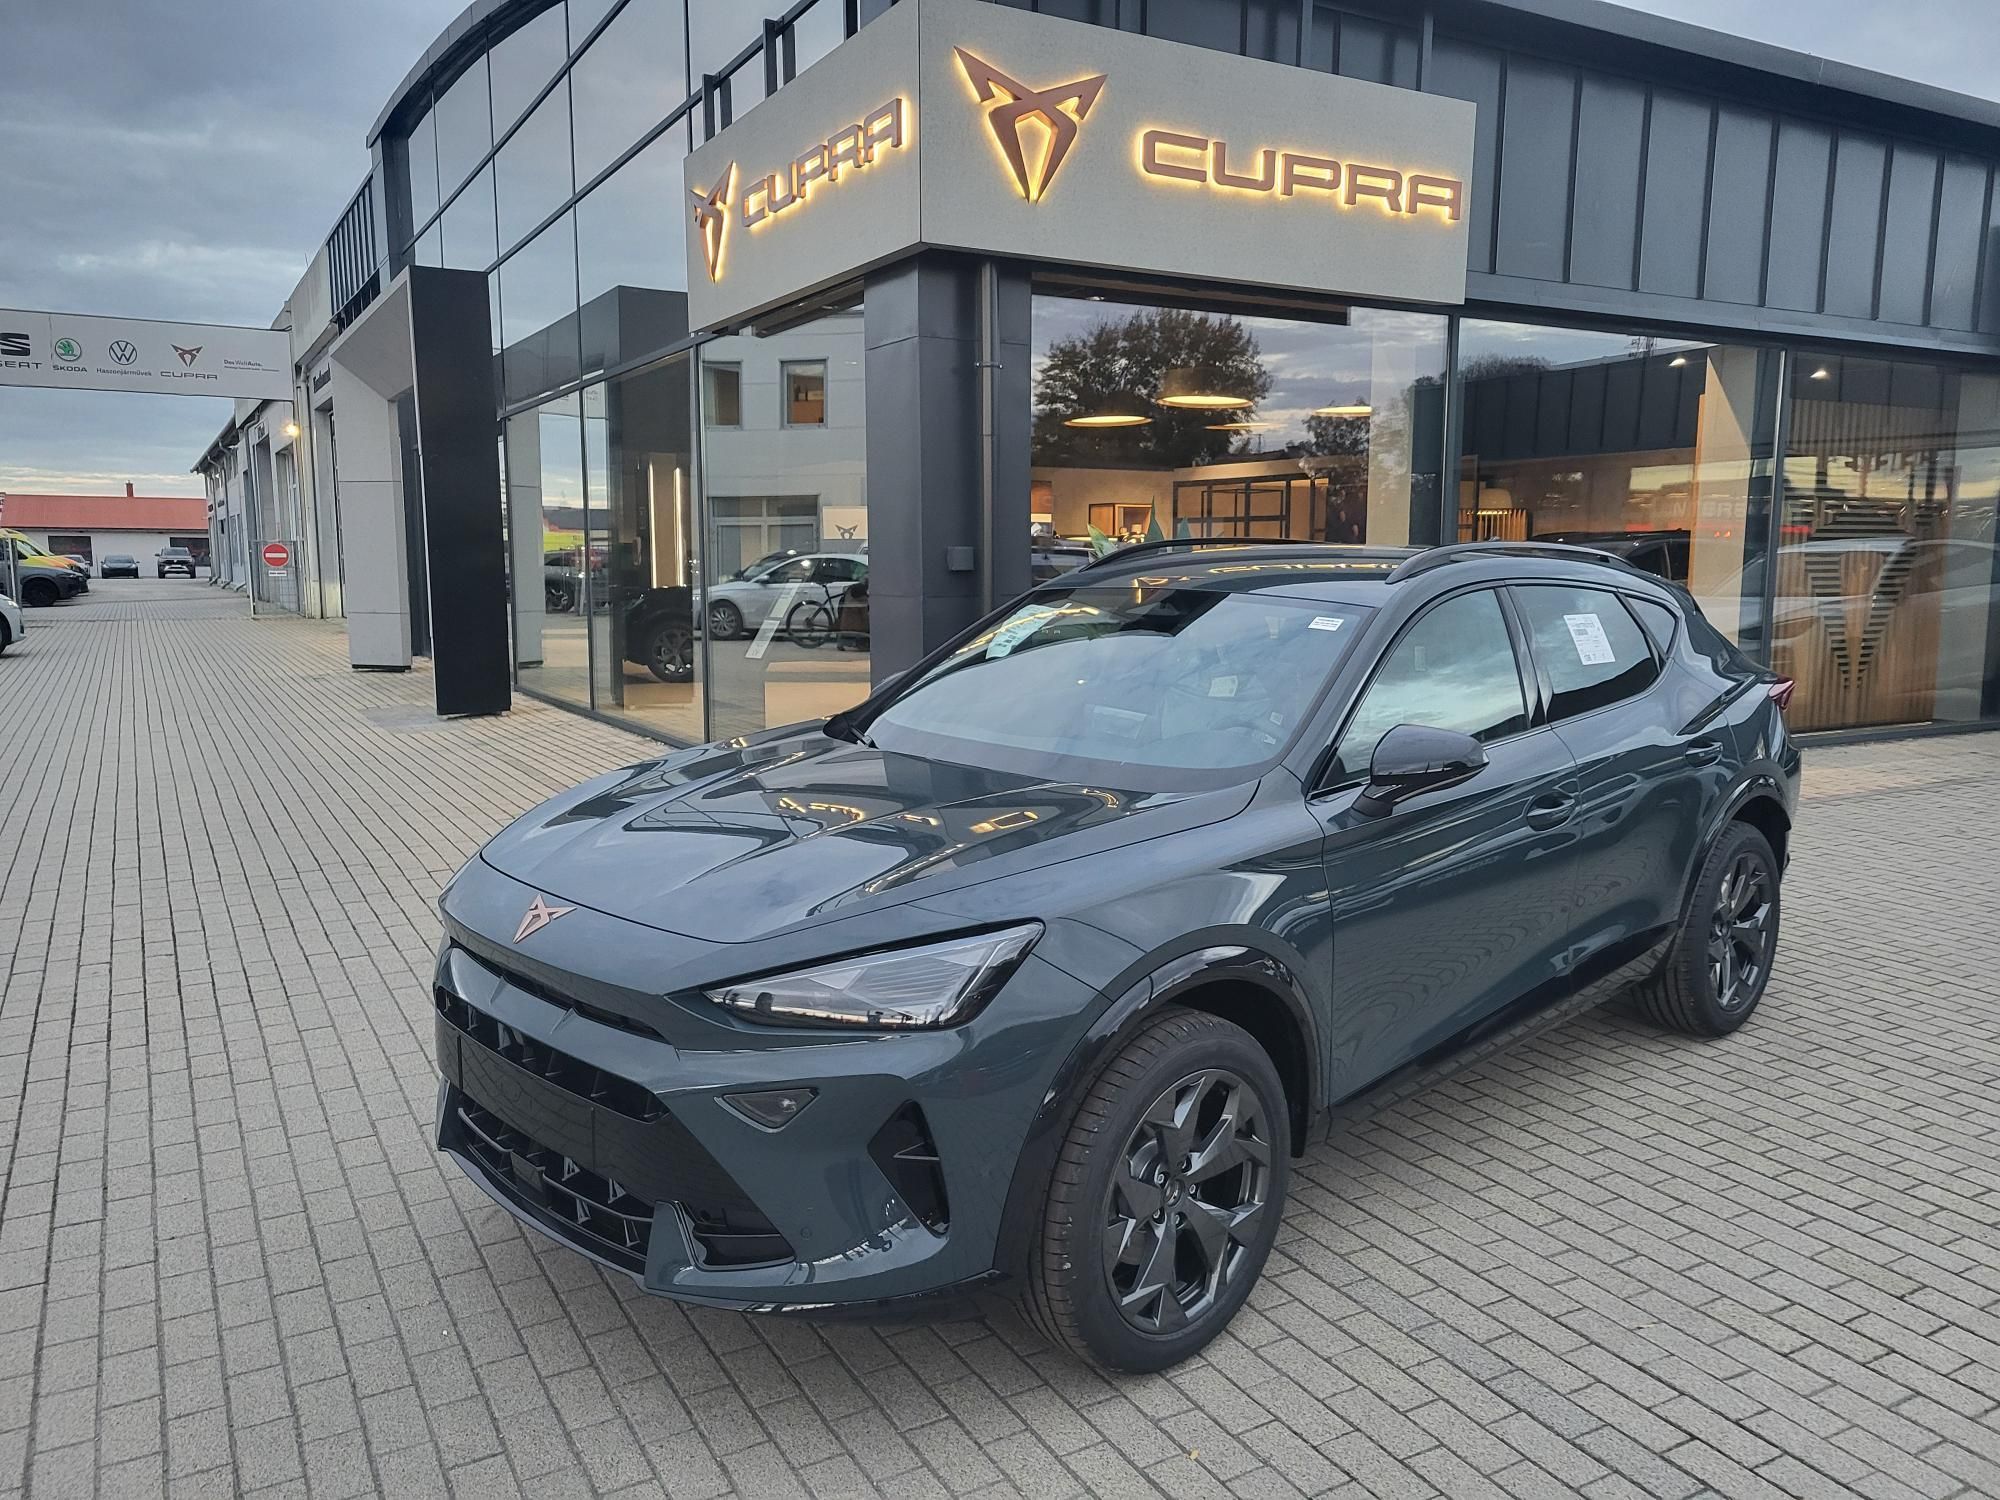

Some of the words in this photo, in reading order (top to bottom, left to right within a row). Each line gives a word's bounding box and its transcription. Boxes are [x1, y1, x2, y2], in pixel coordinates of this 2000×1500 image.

[741, 97, 903, 228] CUPRA
[1142, 129, 1463, 220] CUPRA
[0, 360, 42, 370] EAT
[160, 371, 218, 381] CUPRA
